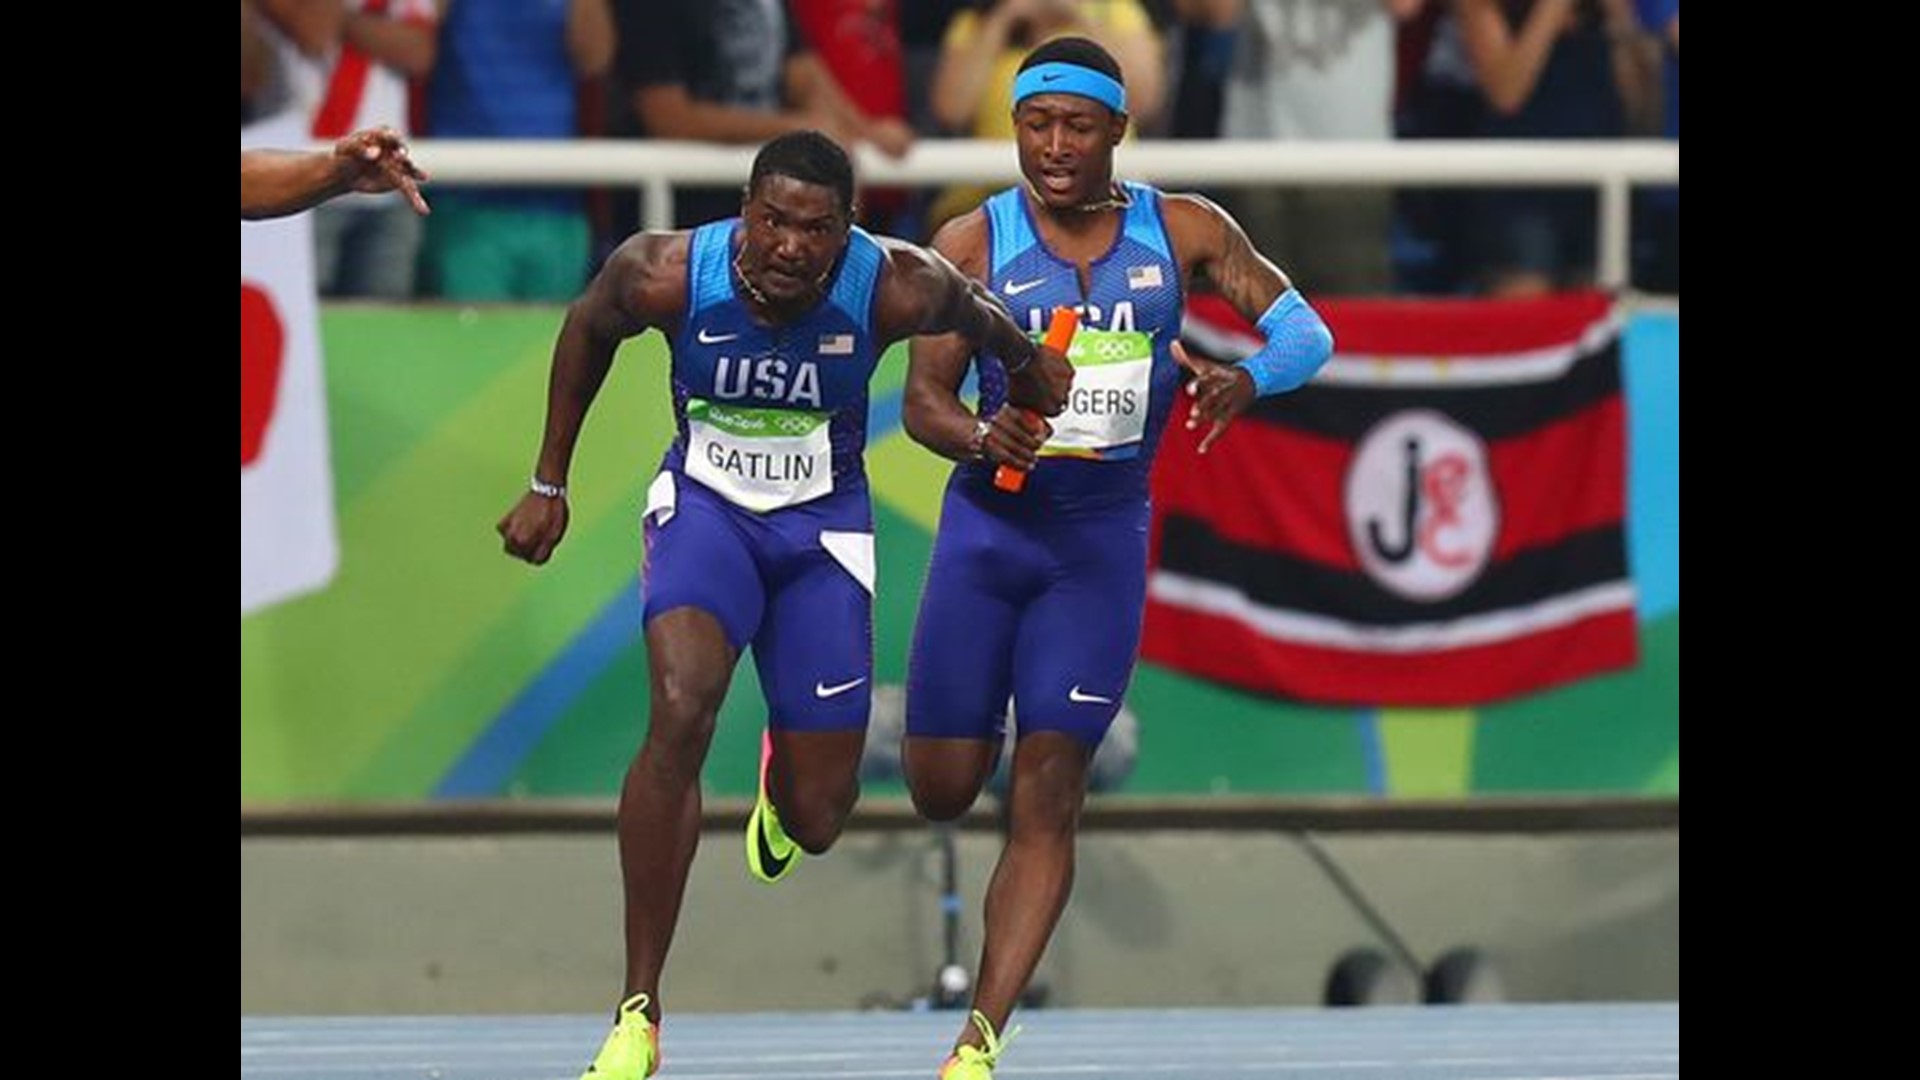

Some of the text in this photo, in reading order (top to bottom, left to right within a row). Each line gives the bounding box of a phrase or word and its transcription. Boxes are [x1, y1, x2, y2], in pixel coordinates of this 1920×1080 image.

[1029, 302, 1135, 333] SA
[714, 357, 822, 408] USA
[1061, 387, 1137, 416] GERS
[707, 441, 814, 481] GATLIN
